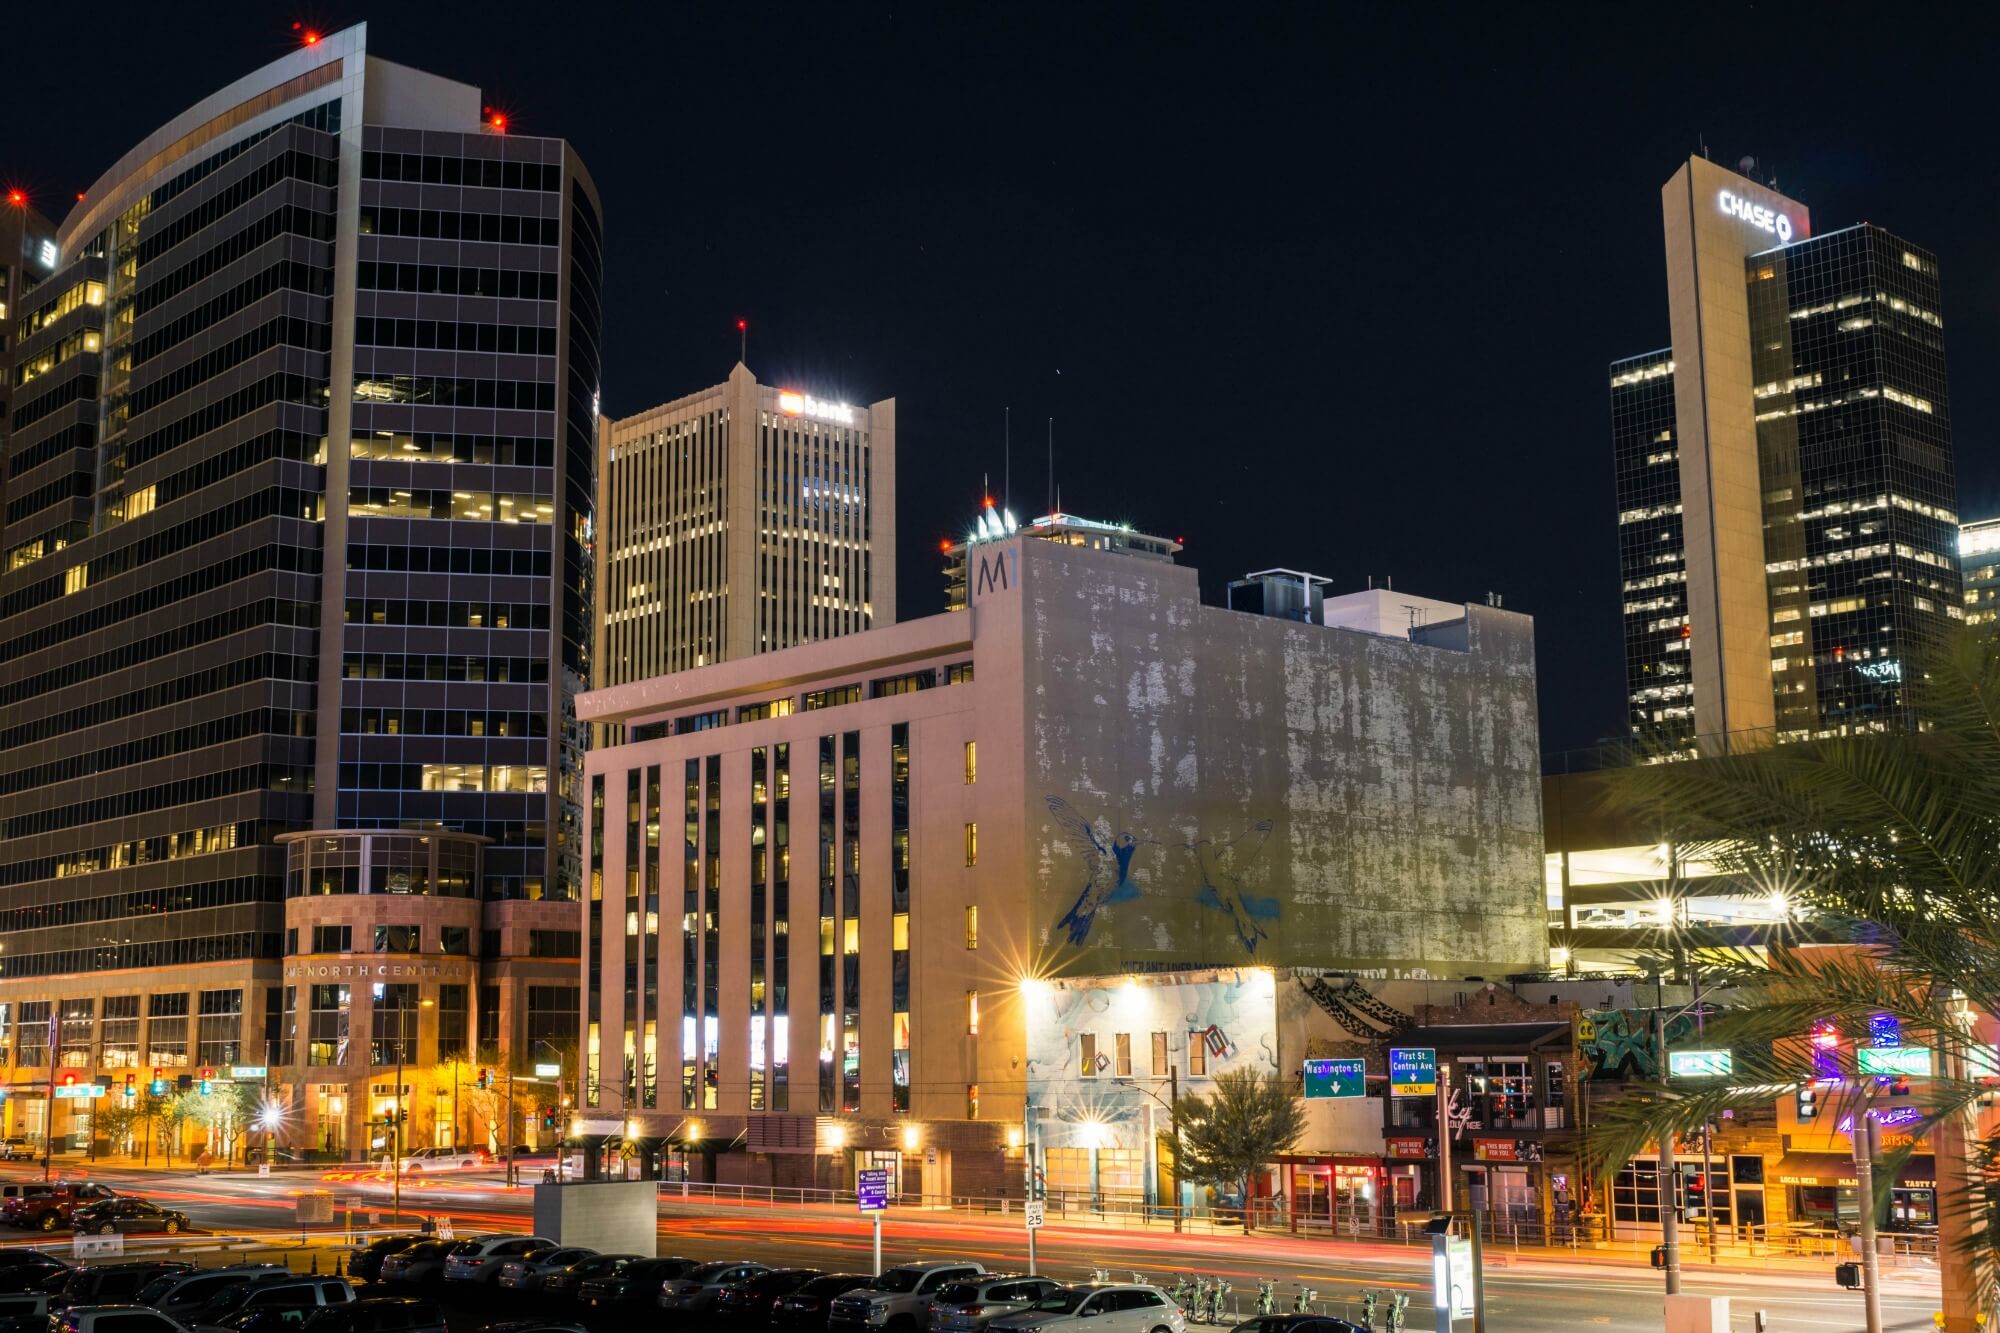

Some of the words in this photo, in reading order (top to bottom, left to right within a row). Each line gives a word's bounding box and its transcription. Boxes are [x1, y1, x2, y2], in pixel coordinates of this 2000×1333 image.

[1719, 190, 1776, 233] CHASE
[307, 966, 369, 977] NORTH
[378, 965, 465, 977] CENTRAL
[1398, 1051, 1416, 1060] First
[1306, 1062, 1351, 1076] Washington
[1393, 1062, 1418, 1071] Central
[1420, 1062, 1434, 1071] Ave.
[1403, 1085, 1422, 1093] ONLY
[1780, 1176, 1800, 1185] LOCAL
[1904, 1180, 1930, 1188] TASTY
[1028, 1215, 1042, 1226] 25
